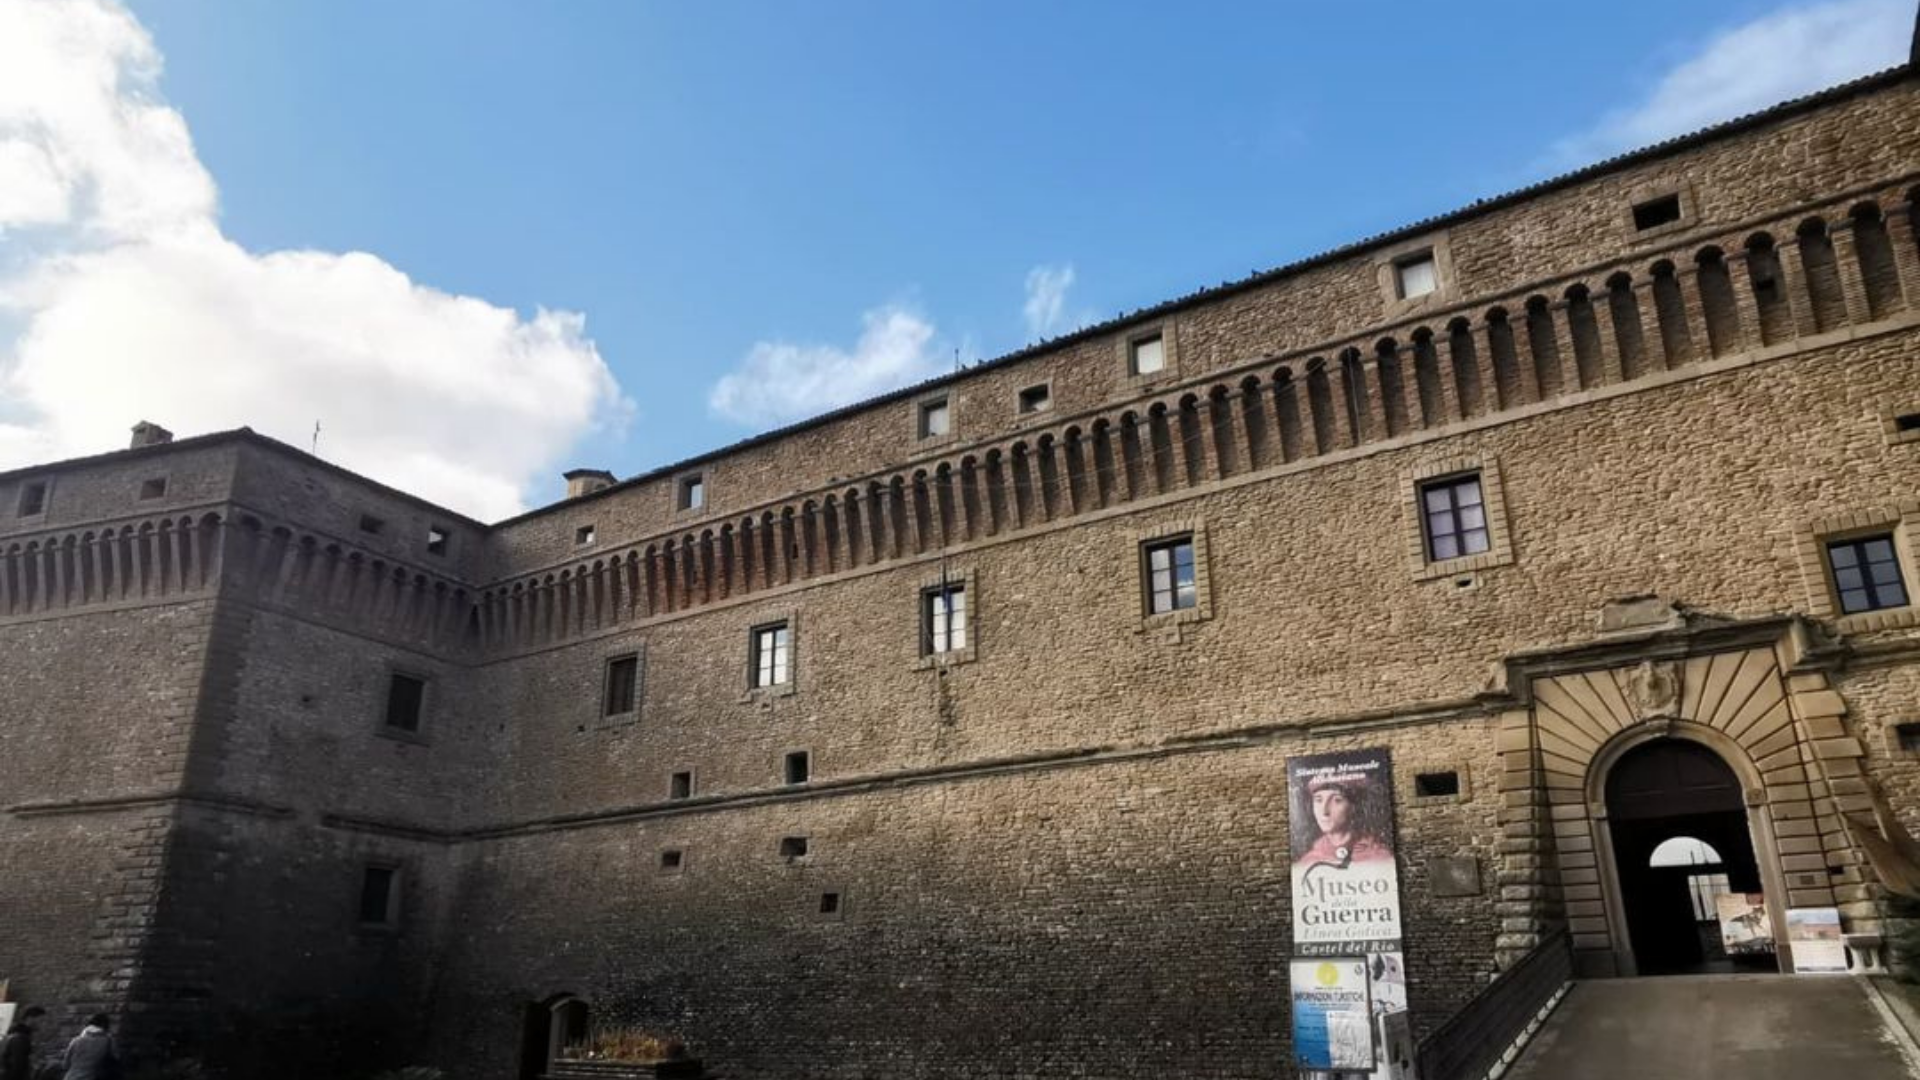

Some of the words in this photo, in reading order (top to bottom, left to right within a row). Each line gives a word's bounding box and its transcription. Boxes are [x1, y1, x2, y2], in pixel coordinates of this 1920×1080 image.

[1301, 876, 1390, 903] Museo
[1301, 904, 1393, 926] Guerra
[1302, 941, 1343, 955] Castel
[1345, 940, 1367, 953] del
[1371, 940, 1395, 952] Rio
